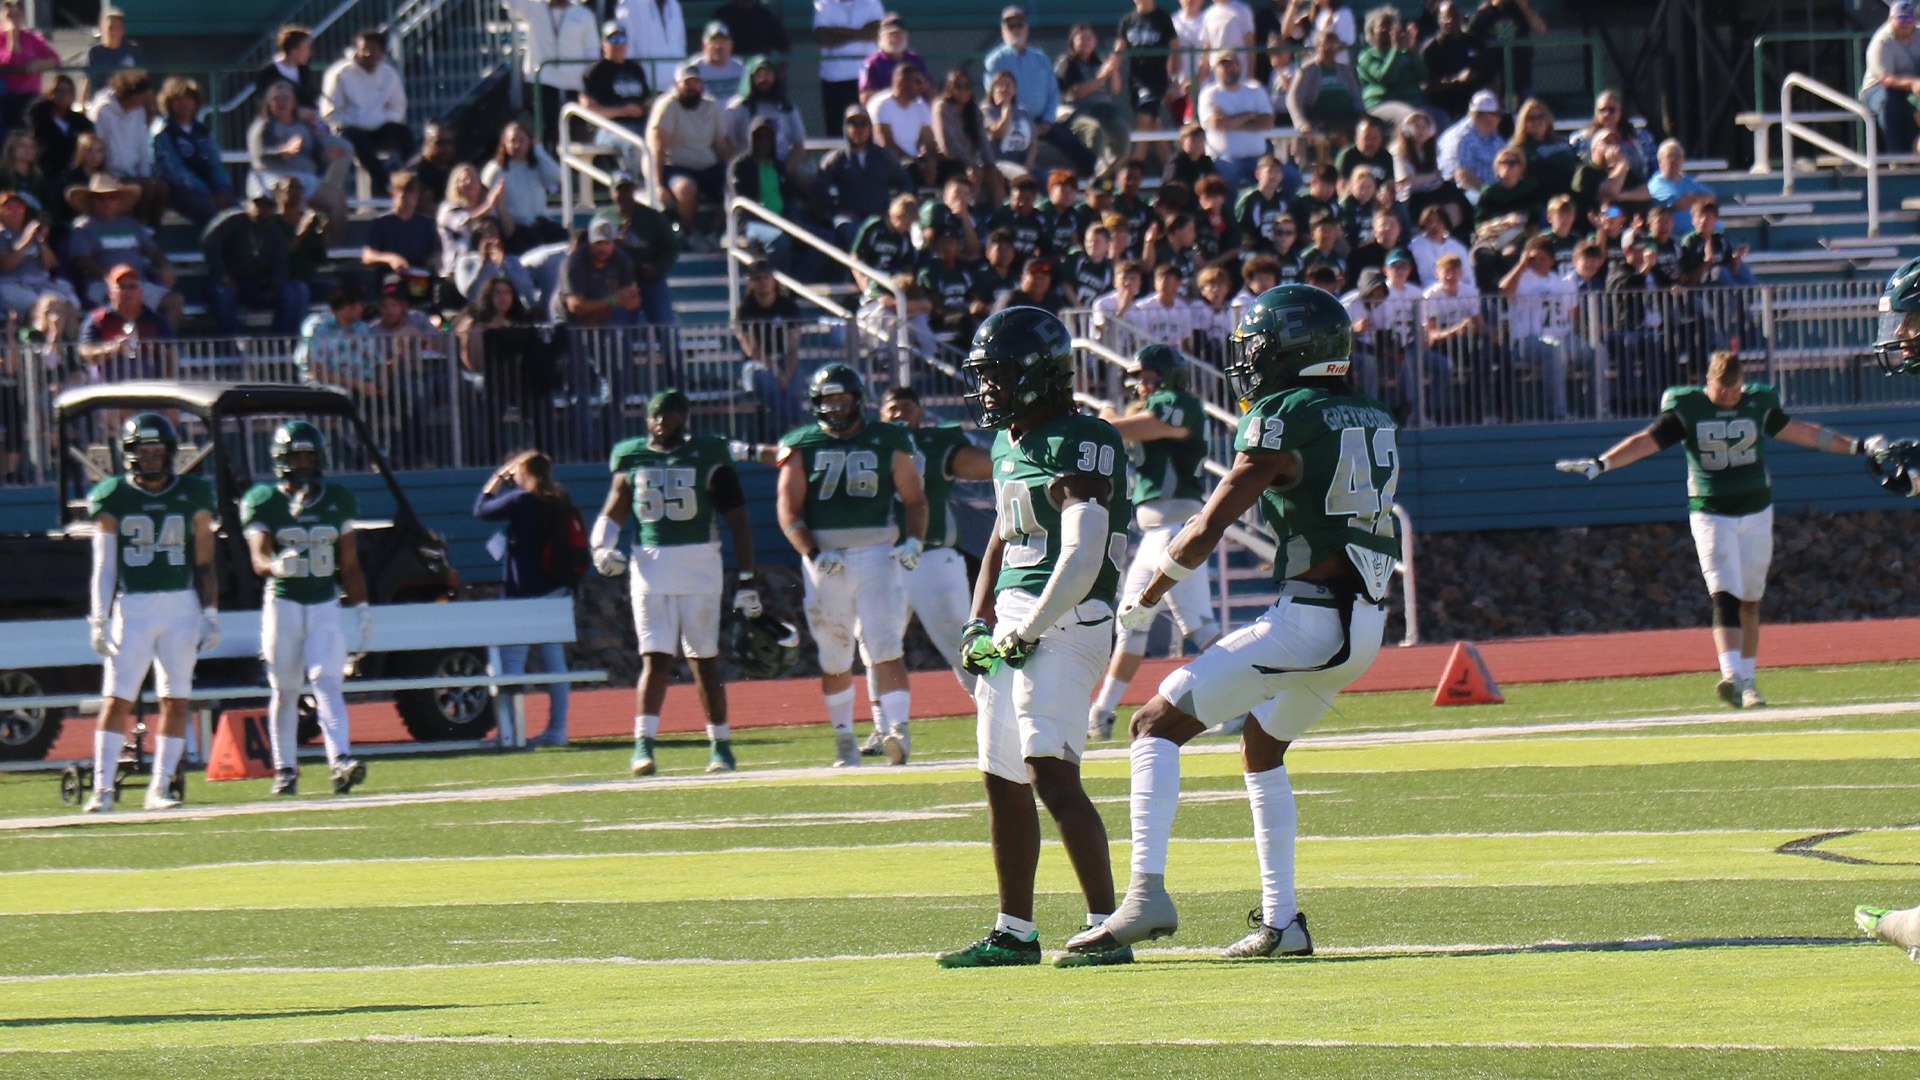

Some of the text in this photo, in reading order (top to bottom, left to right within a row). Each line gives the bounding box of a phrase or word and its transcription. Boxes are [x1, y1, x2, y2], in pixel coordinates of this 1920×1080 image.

[1077, 441, 1115, 476] 30
[1243, 416, 1284, 450] 42
[1696, 418, 1758, 471] 52
[634, 468, 698, 522] 55
[813, 451, 879, 500] 76
[1325, 427, 1400, 538] 42
[120, 514, 187, 567] 34
[993, 478, 1049, 568] 0
